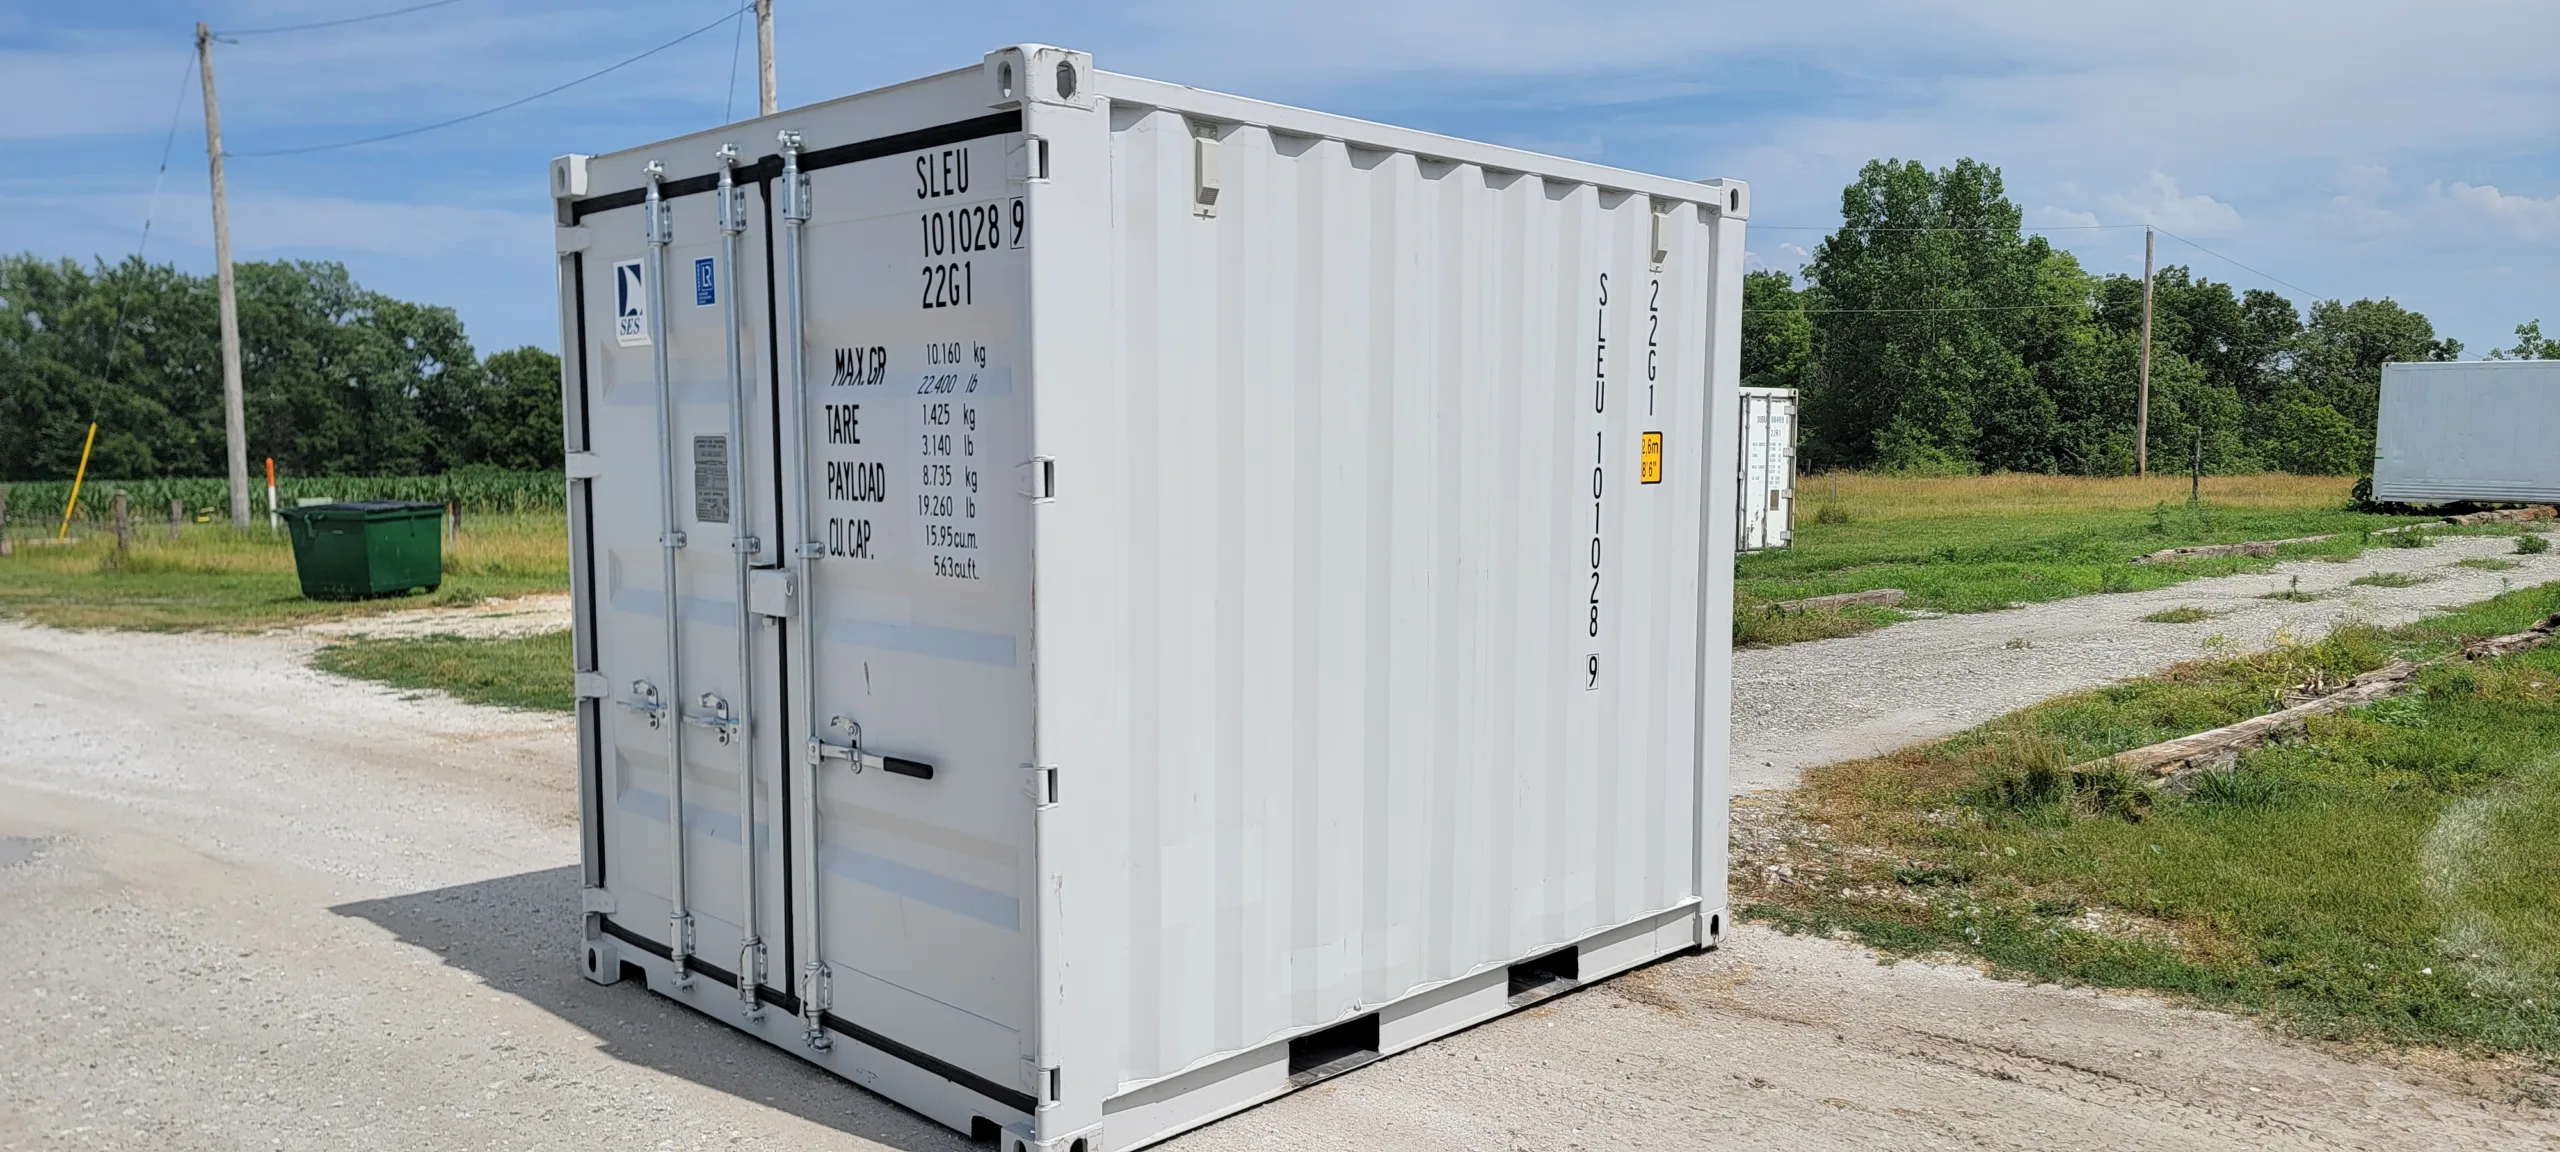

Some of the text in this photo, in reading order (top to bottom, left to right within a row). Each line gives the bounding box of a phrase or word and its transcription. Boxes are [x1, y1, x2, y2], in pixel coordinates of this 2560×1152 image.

[916, 148, 969, 199] SLEU
[921, 200, 1024, 257] 101028 9
[922, 261, 971, 309] 22G1
[620, 317, 640, 336] SES
[973, 341, 986, 368] kg
[1648, 279, 1659, 416] 22G1
[965, 373, 978, 394] lb
[826, 404, 861, 444] TARE
[963, 403, 976, 431] kg
[964, 434, 974, 457] lb
[828, 461, 886, 503] PAYLOAD
[965, 466, 978, 493] kg
[1588, 273, 1608, 688] SLEU 101028 9
[966, 497, 976, 519] lb
